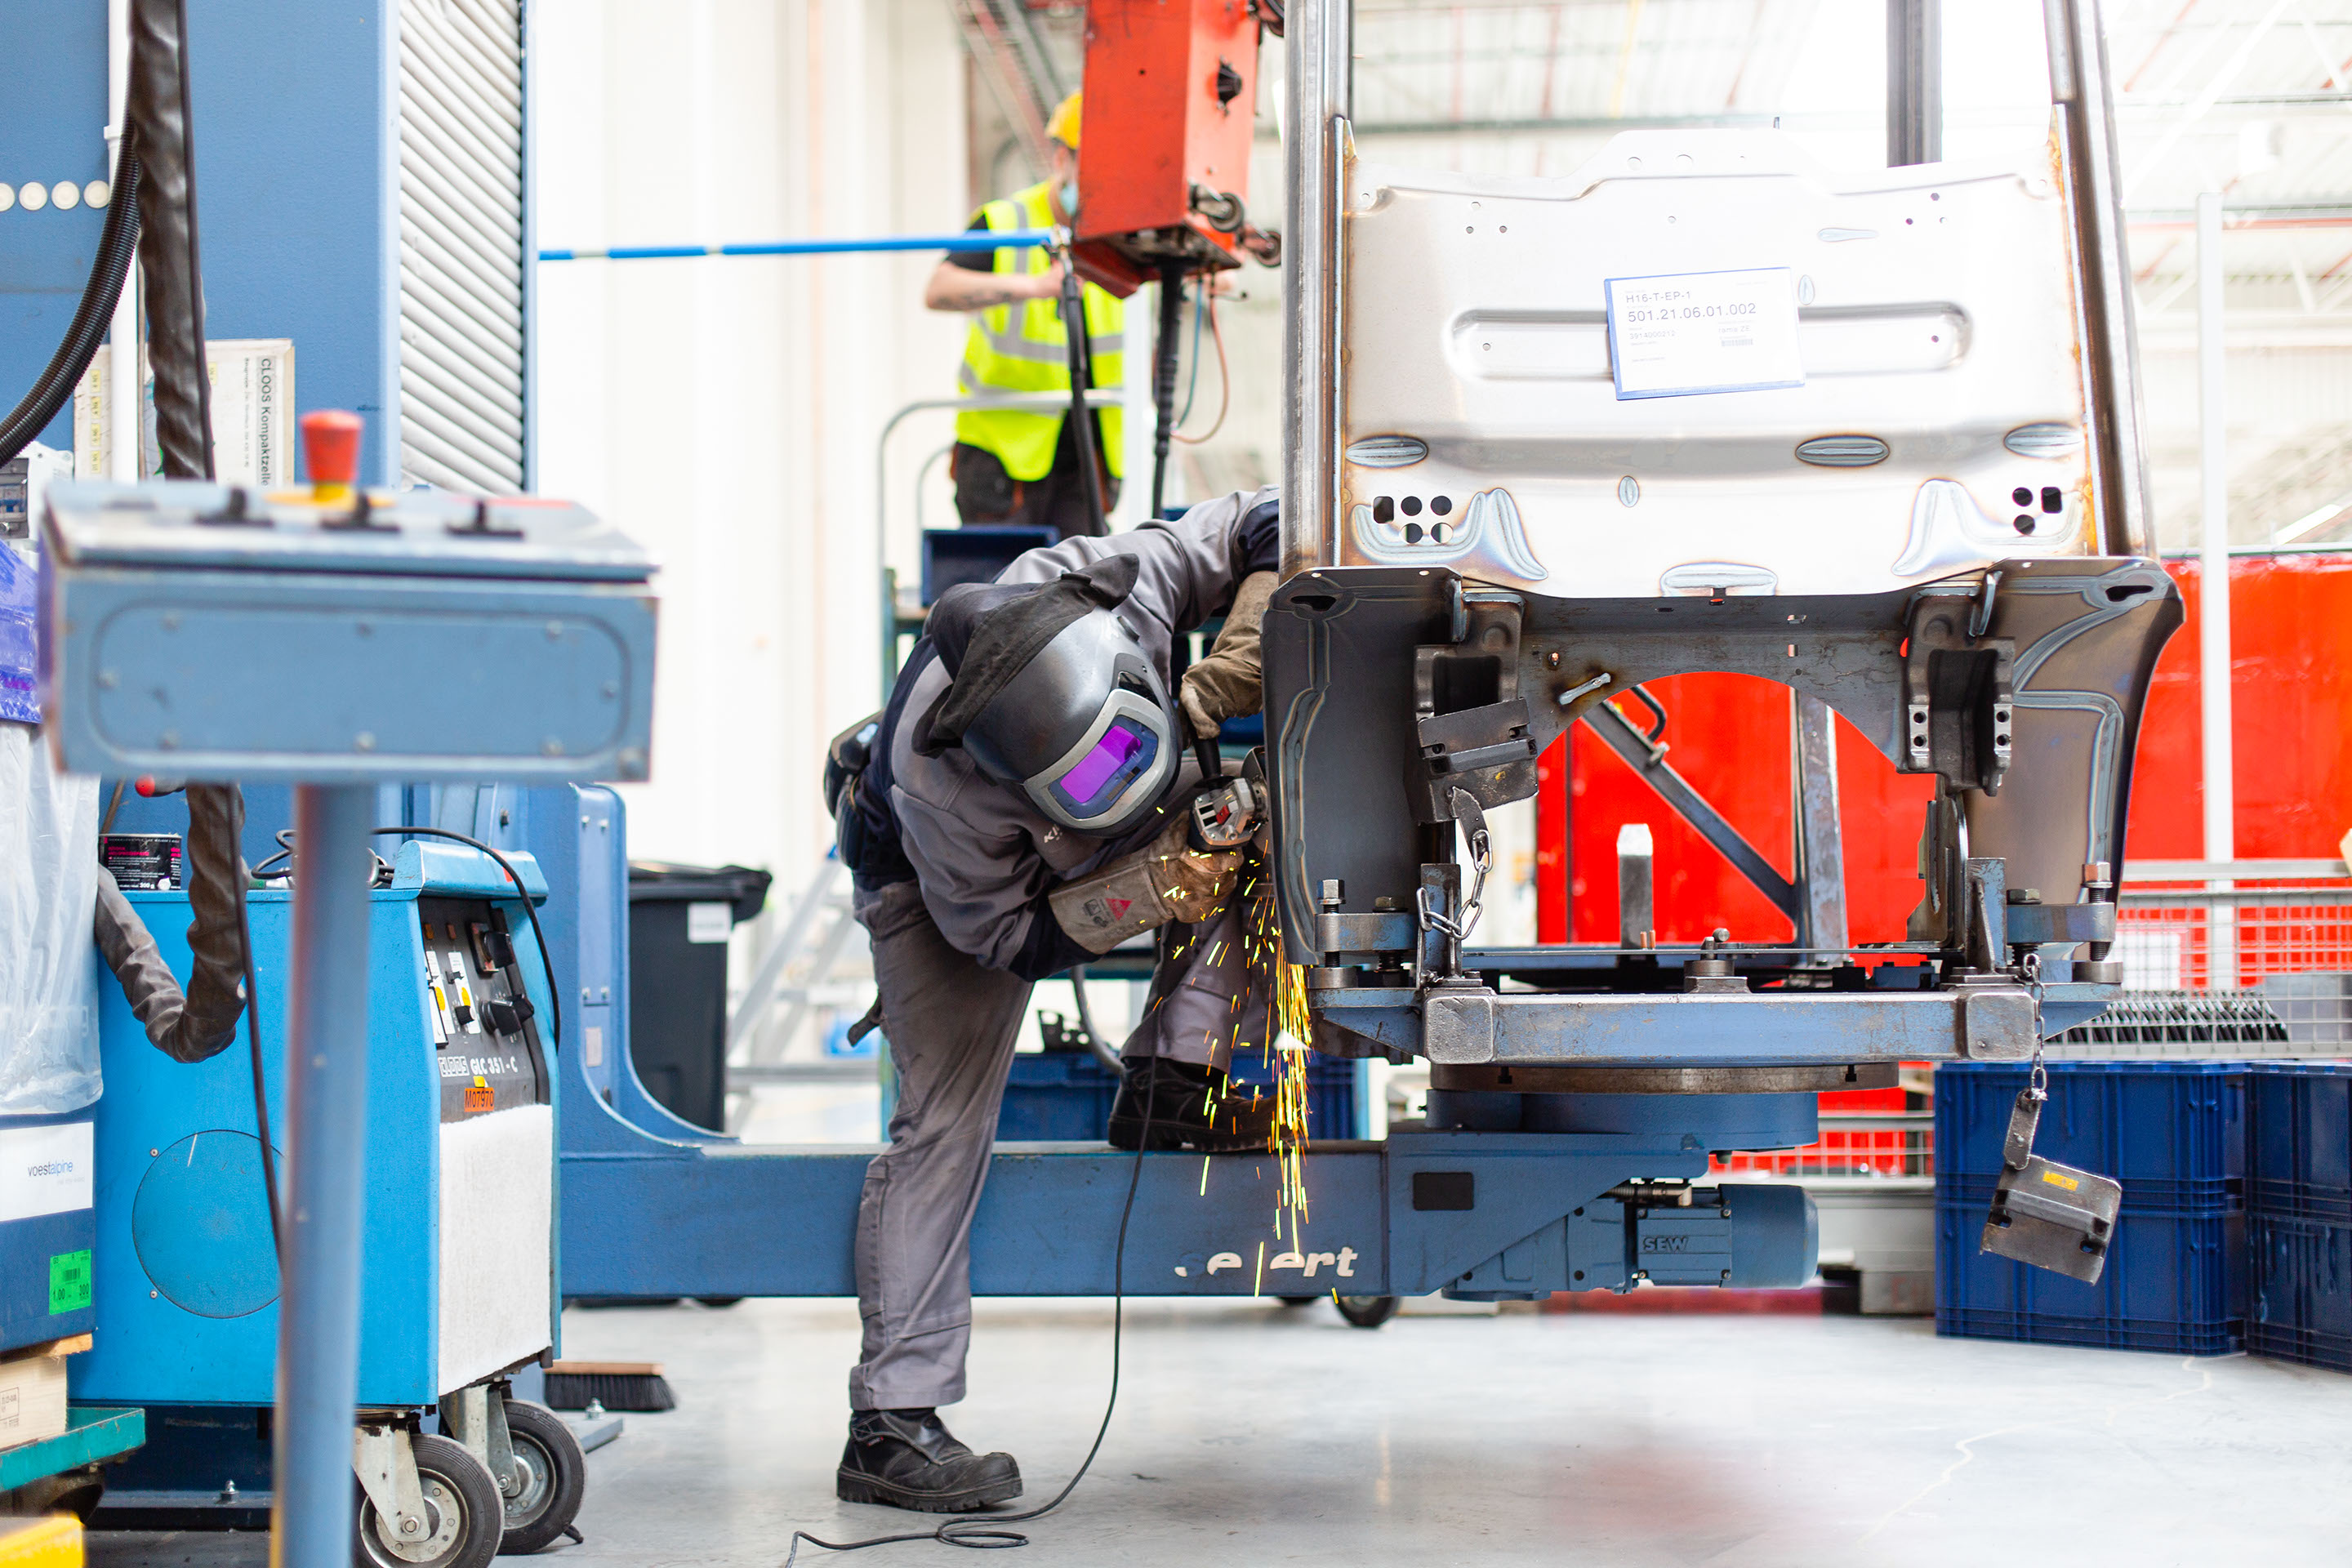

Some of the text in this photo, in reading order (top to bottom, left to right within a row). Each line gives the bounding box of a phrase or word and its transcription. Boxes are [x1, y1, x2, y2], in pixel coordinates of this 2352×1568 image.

[1626, 291, 1691, 303] H16-T-EP-1
[1628, 302, 1757, 323] 501.21.06.01.002
[259, 358, 272, 486] CLOOS Kompaktzelle
[470, 1058, 488, 1075] GLC
[466, 1090, 493, 1107] M07970
[28, 1159, 74, 1177] voestalpine
[1643, 1236, 1689, 1252] SEW
